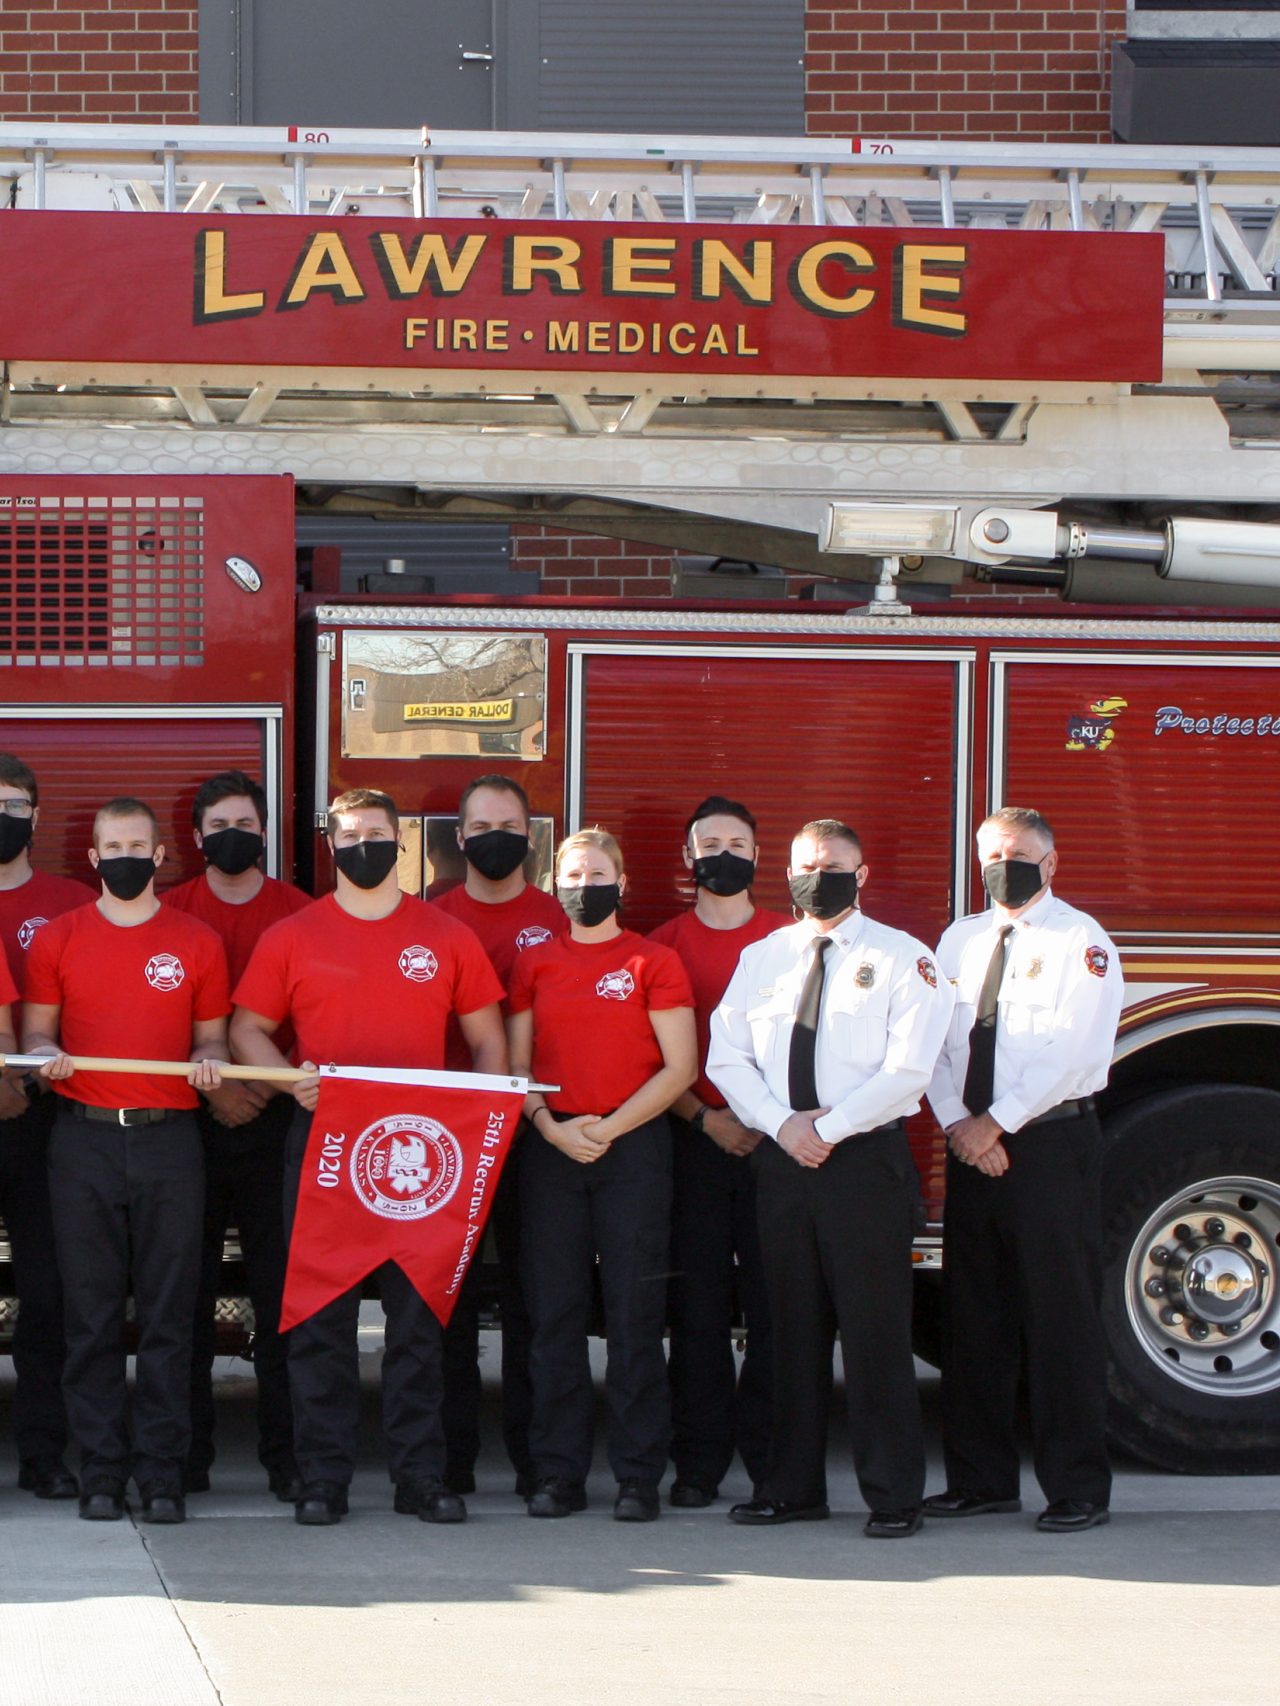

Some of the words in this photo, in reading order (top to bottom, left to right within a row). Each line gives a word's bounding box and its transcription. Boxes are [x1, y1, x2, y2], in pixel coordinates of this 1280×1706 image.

[304, 132, 330, 144] 80
[869, 144, 894, 155] 70
[194, 228, 967, 338] LAWRENCE
[405, 317, 510, 351] FIRE
[547, 320, 760, 356] MEDICAL
[1081, 725, 1099, 738] KU
[482, 1111, 505, 1149] 25th
[316, 1132, 346, 1188] 2020
[357, 1135, 375, 1187] KANSAS
[435, 1141, 456, 1200] LAWRENCE
